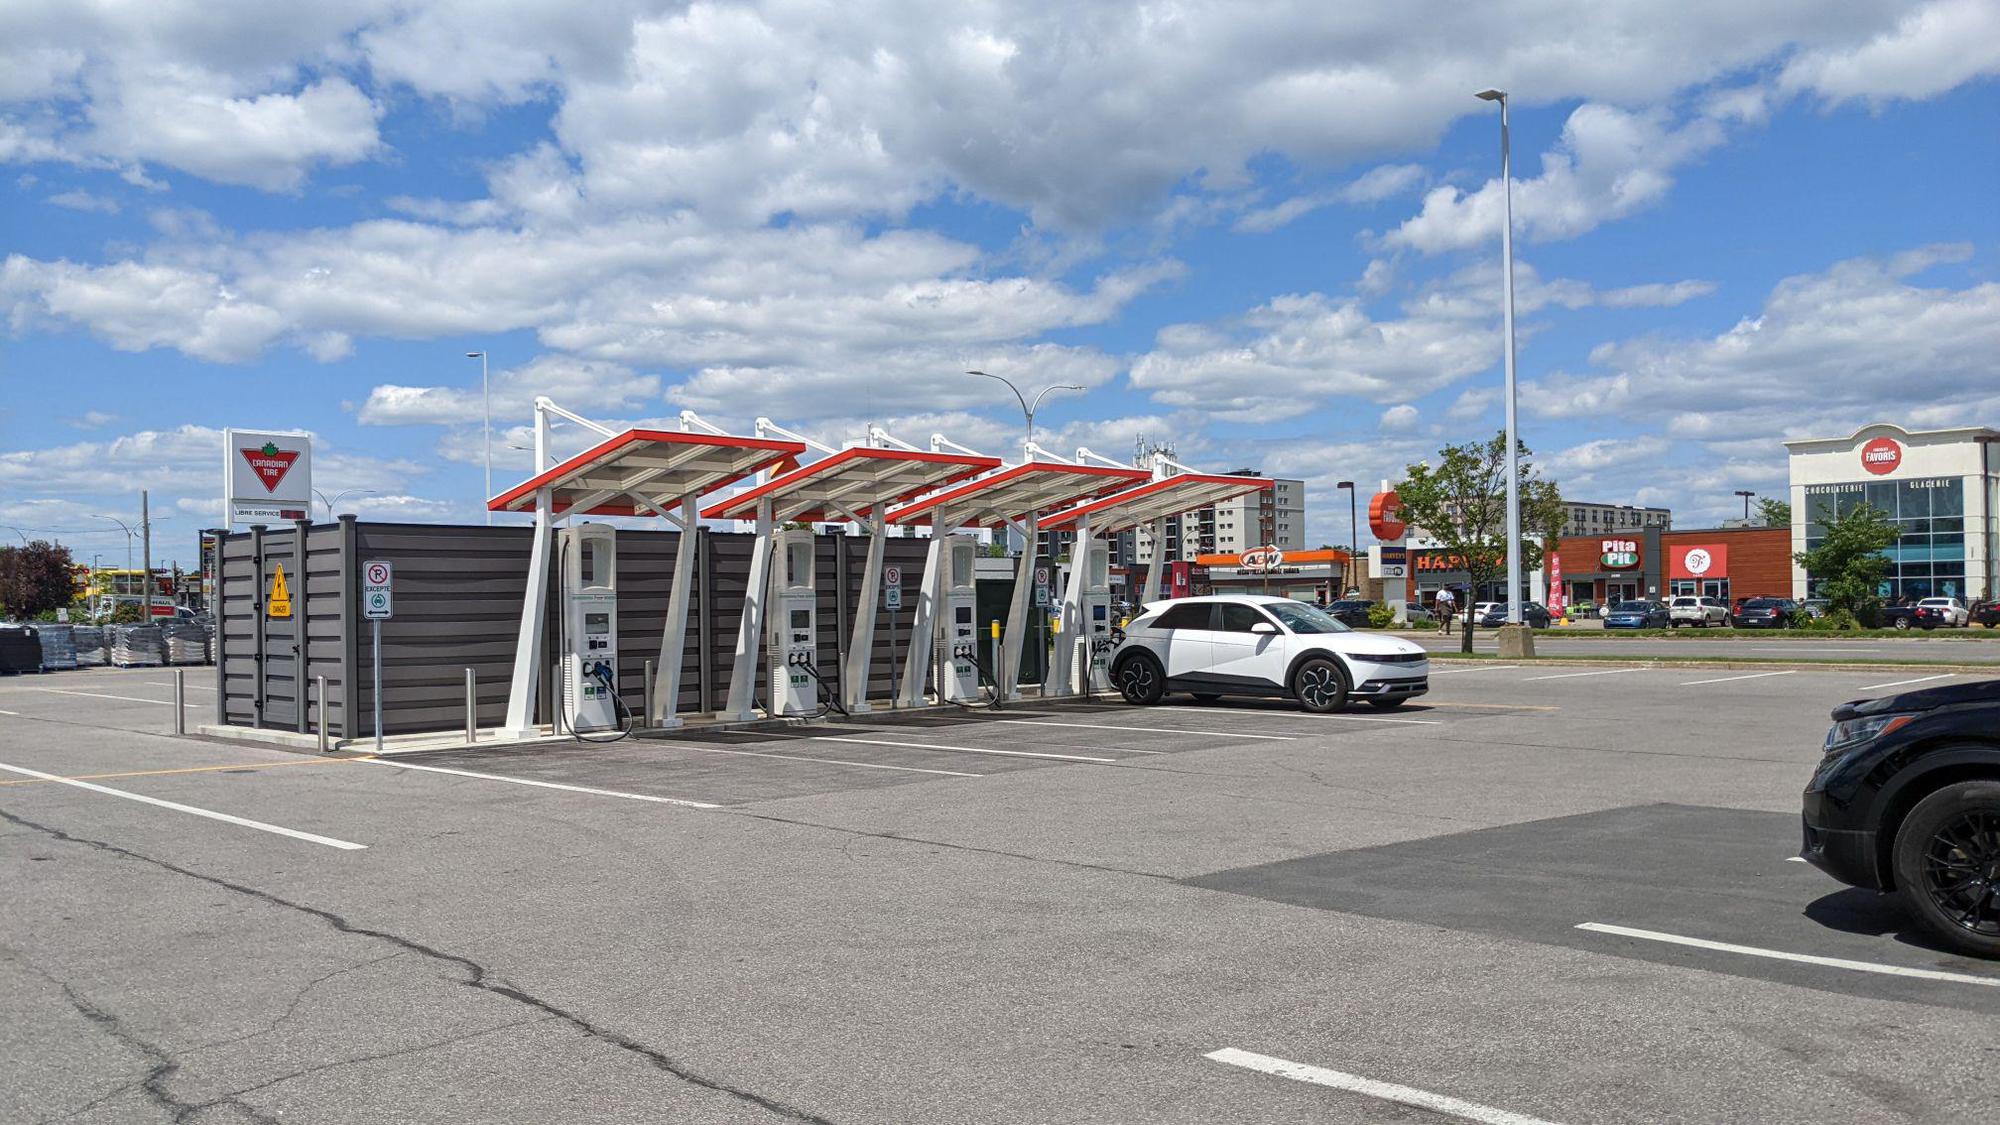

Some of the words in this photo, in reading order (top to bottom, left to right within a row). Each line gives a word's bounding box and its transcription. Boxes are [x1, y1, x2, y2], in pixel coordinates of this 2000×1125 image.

[1866, 451, 1896, 462] FAVORIS
[252, 459, 289, 468] CANADIAN
[263, 468, 279, 476] TIRE
[1805, 484, 1864, 495] CHOCOLATERIE
[1910, 479, 1950, 489] GLACERIE
[1602, 540, 1636, 553] Pita
[1607, 552, 1631, 565] Pit
